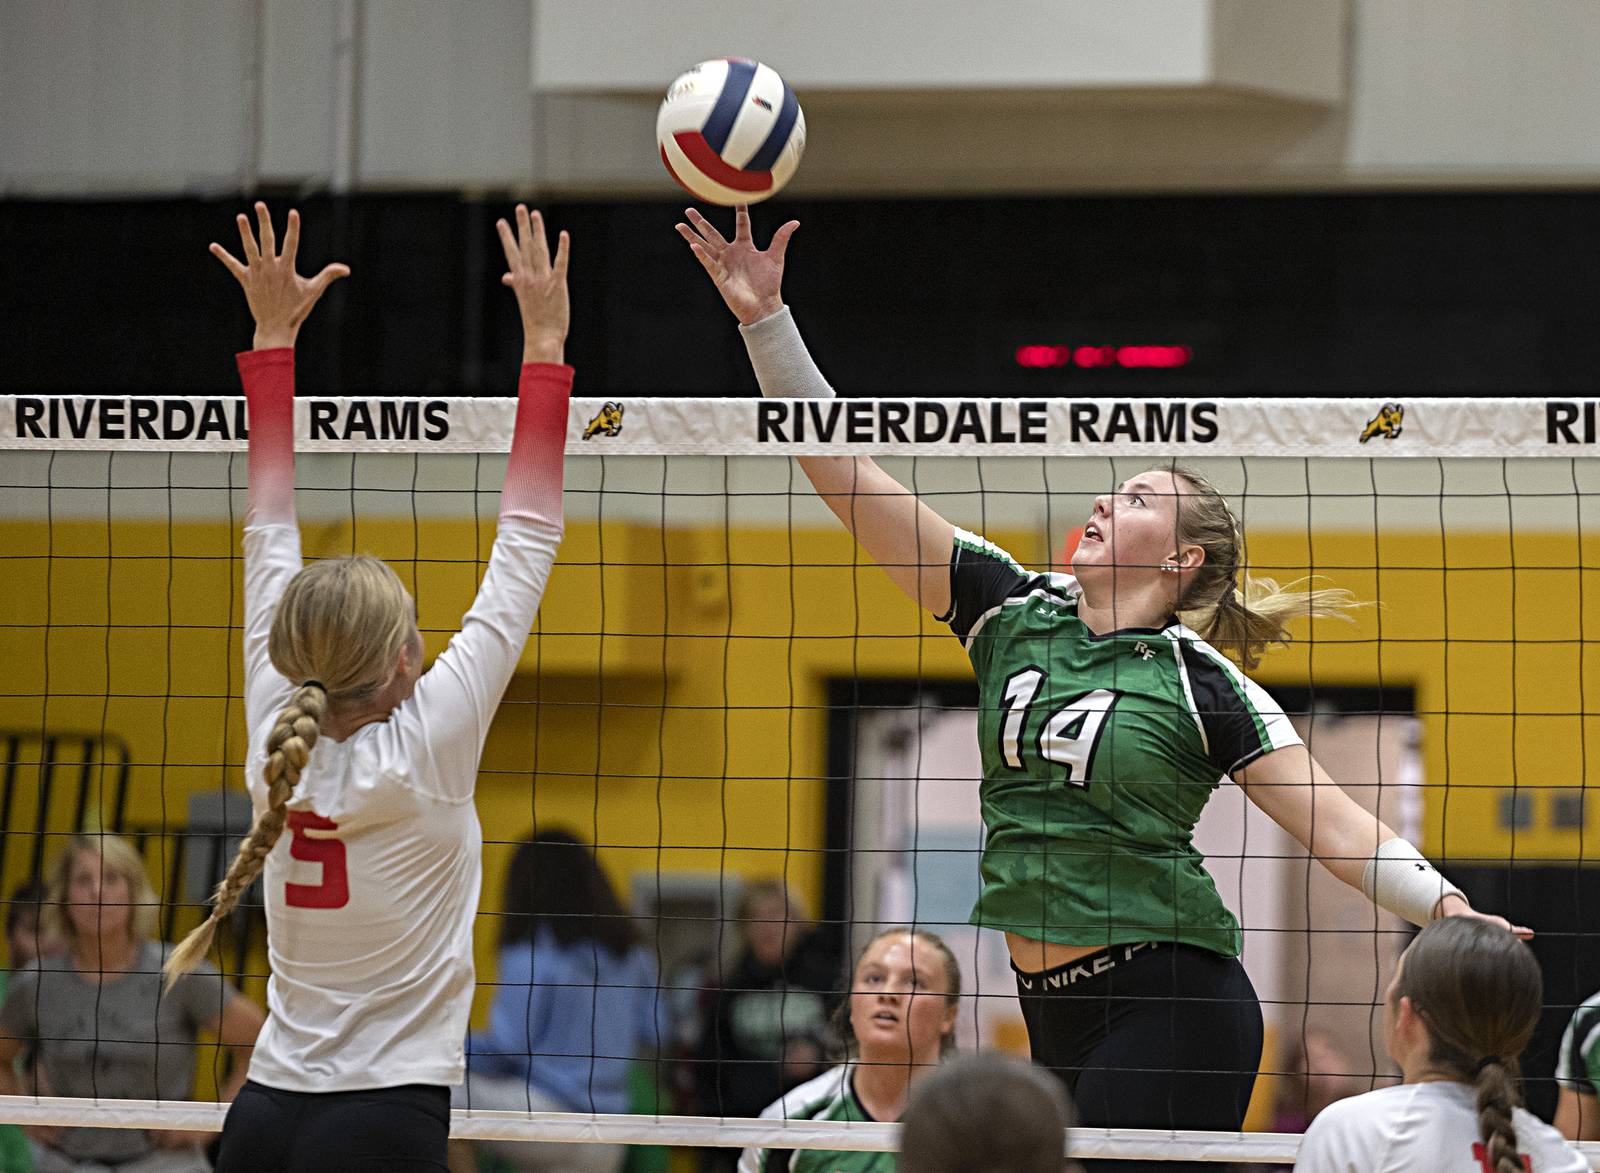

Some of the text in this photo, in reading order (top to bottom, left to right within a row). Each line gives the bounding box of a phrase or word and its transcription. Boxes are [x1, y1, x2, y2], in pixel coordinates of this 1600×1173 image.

[15, 398, 450, 441] RIVERDAL RAMS
[757, 401, 1219, 443] RIVERDALE RAMS
[1546, 401, 1600, 444] RI
[998, 664, 1124, 791] 14
[284, 808, 350, 909] 5
[1043, 954, 1116, 991] NIKE
